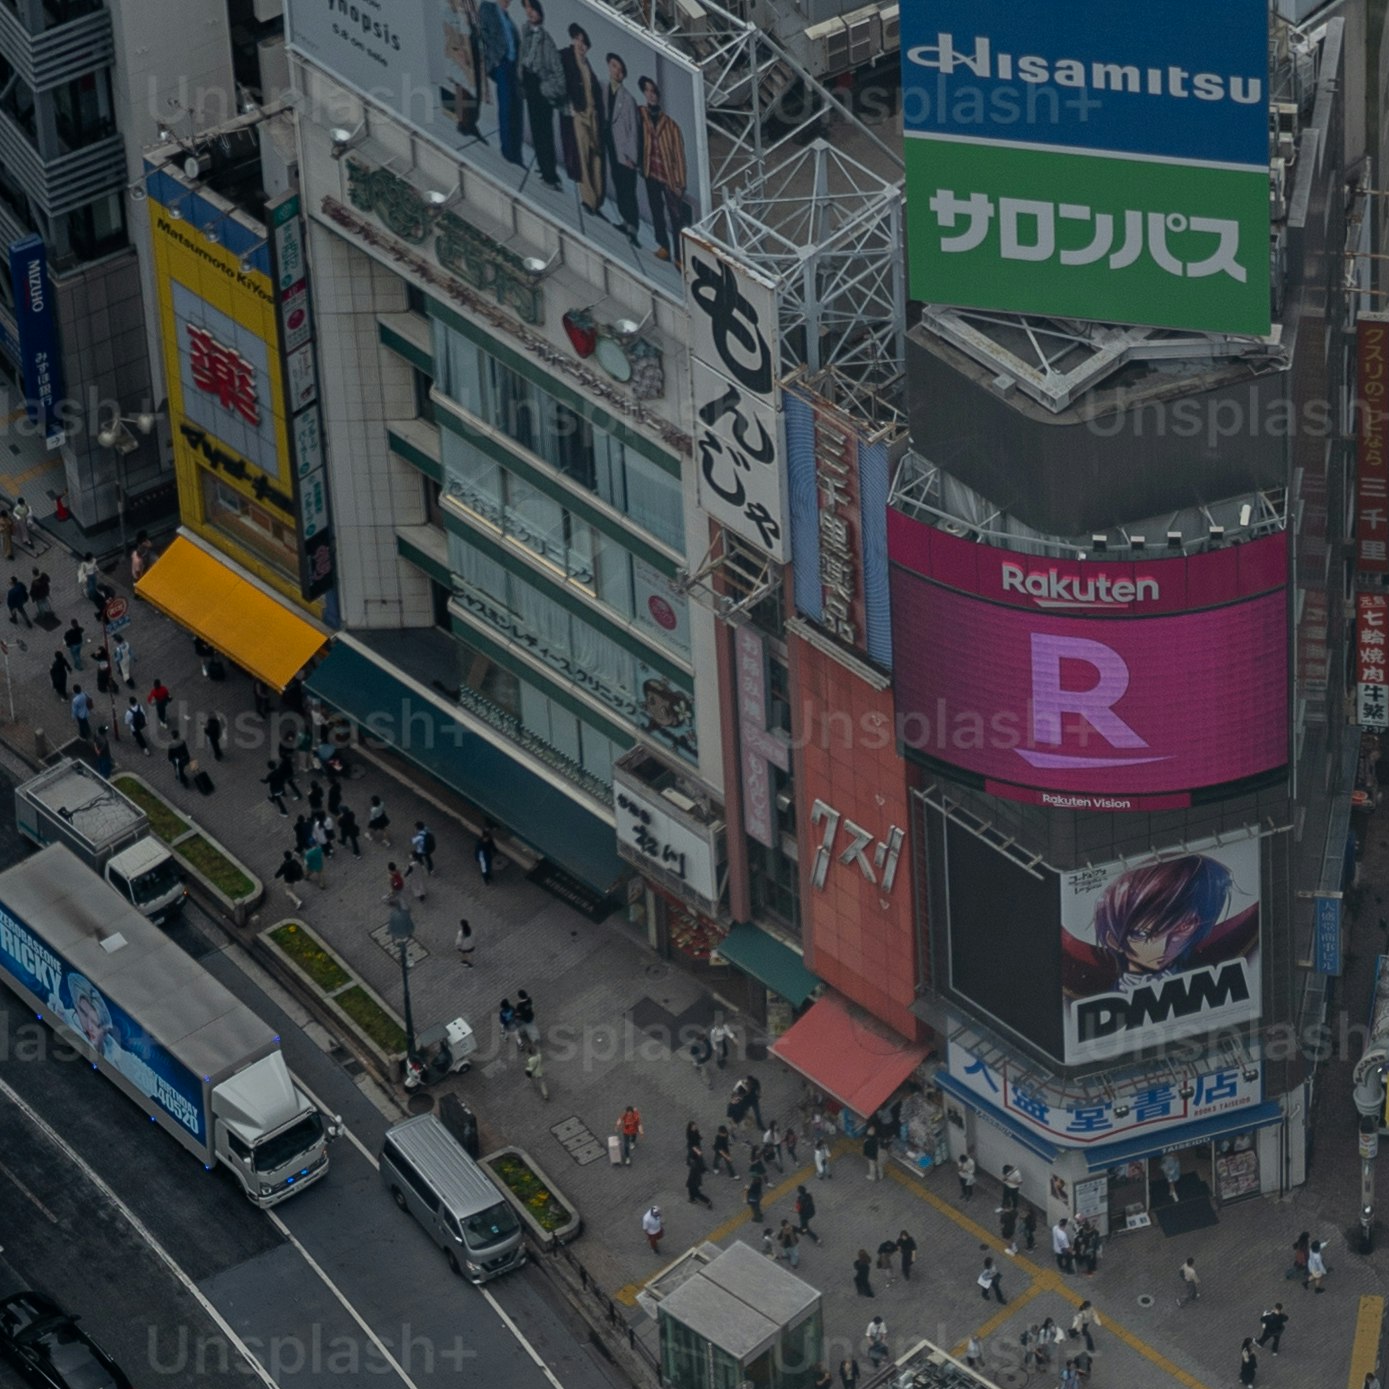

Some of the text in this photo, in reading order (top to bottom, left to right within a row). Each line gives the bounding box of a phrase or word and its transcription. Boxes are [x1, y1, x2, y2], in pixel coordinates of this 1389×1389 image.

[906, 32, 1262, 105] Hisamitsu
[156, 217, 275, 305] Matsumoto KiYos
[929, 189, 1248, 284] サロンパス
[27, 259, 43, 313] MIZUHO
[187, 323, 261, 427] 薬
[1360, 477, 1388, 561] 三千里
[1001, 562, 1160, 607] Rakuten
[1360, 611, 1386, 682] 七輪焼肉
[1029, 632, 1150, 749] R
[1043, 794, 1131, 810] Rakuten Vision
[0, 909, 62, 975] ZEROBASEONE
[0, 922, 62, 1000] RICKY
[1077, 961, 1251, 1045] DMM
[964, 1062, 1239, 1132] 大盛堂書店
